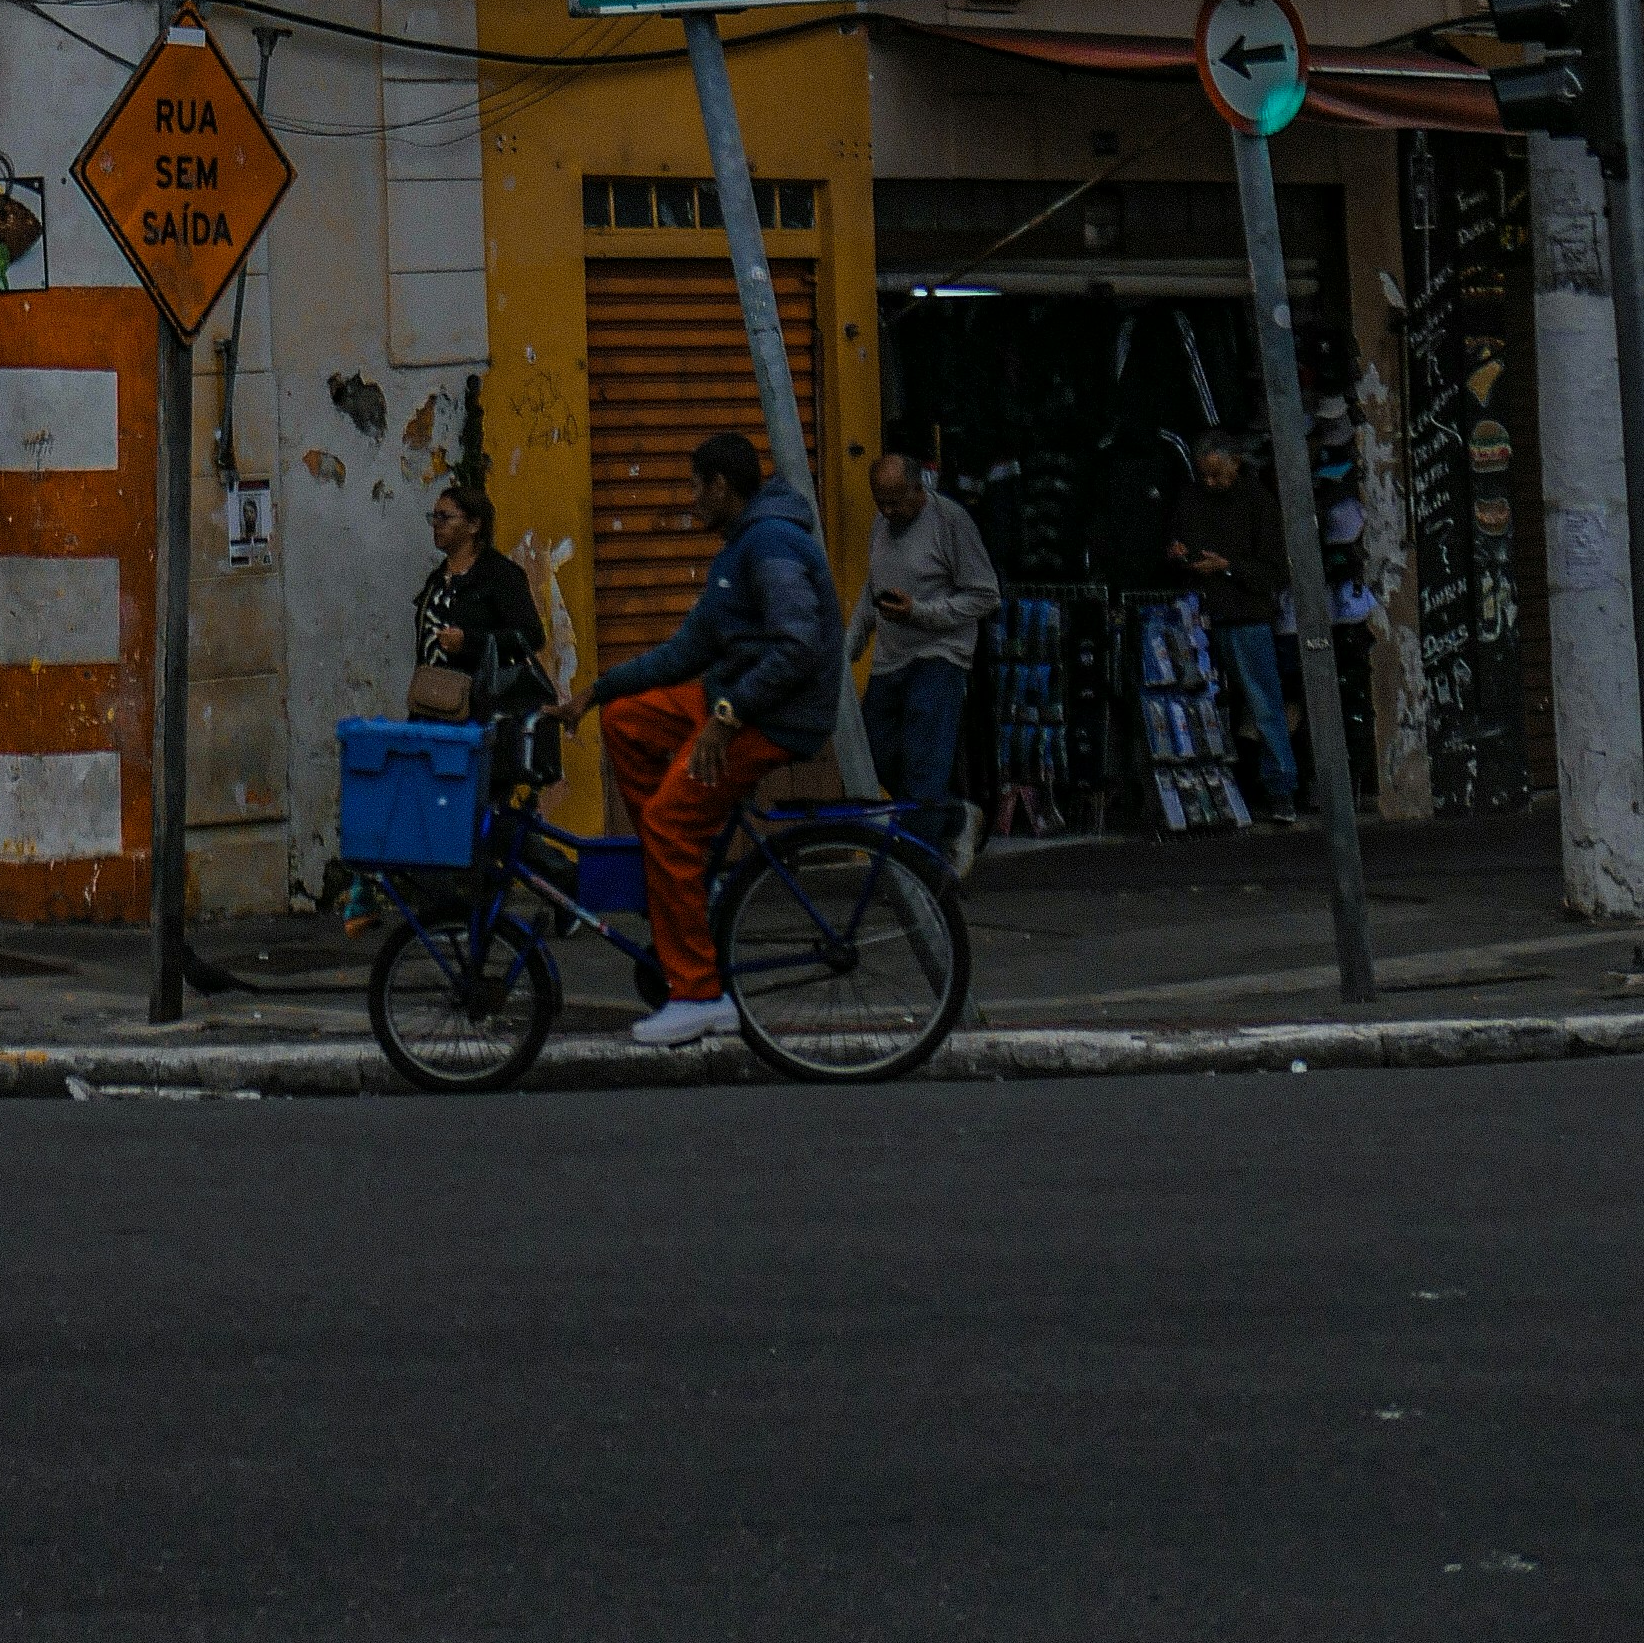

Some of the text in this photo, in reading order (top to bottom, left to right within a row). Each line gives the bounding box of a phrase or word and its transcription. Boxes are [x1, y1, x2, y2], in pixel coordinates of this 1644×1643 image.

[155, 98, 219, 135] RUA
[155, 154, 219, 191] SEM
[142, 202, 233, 247] SAÍDA
